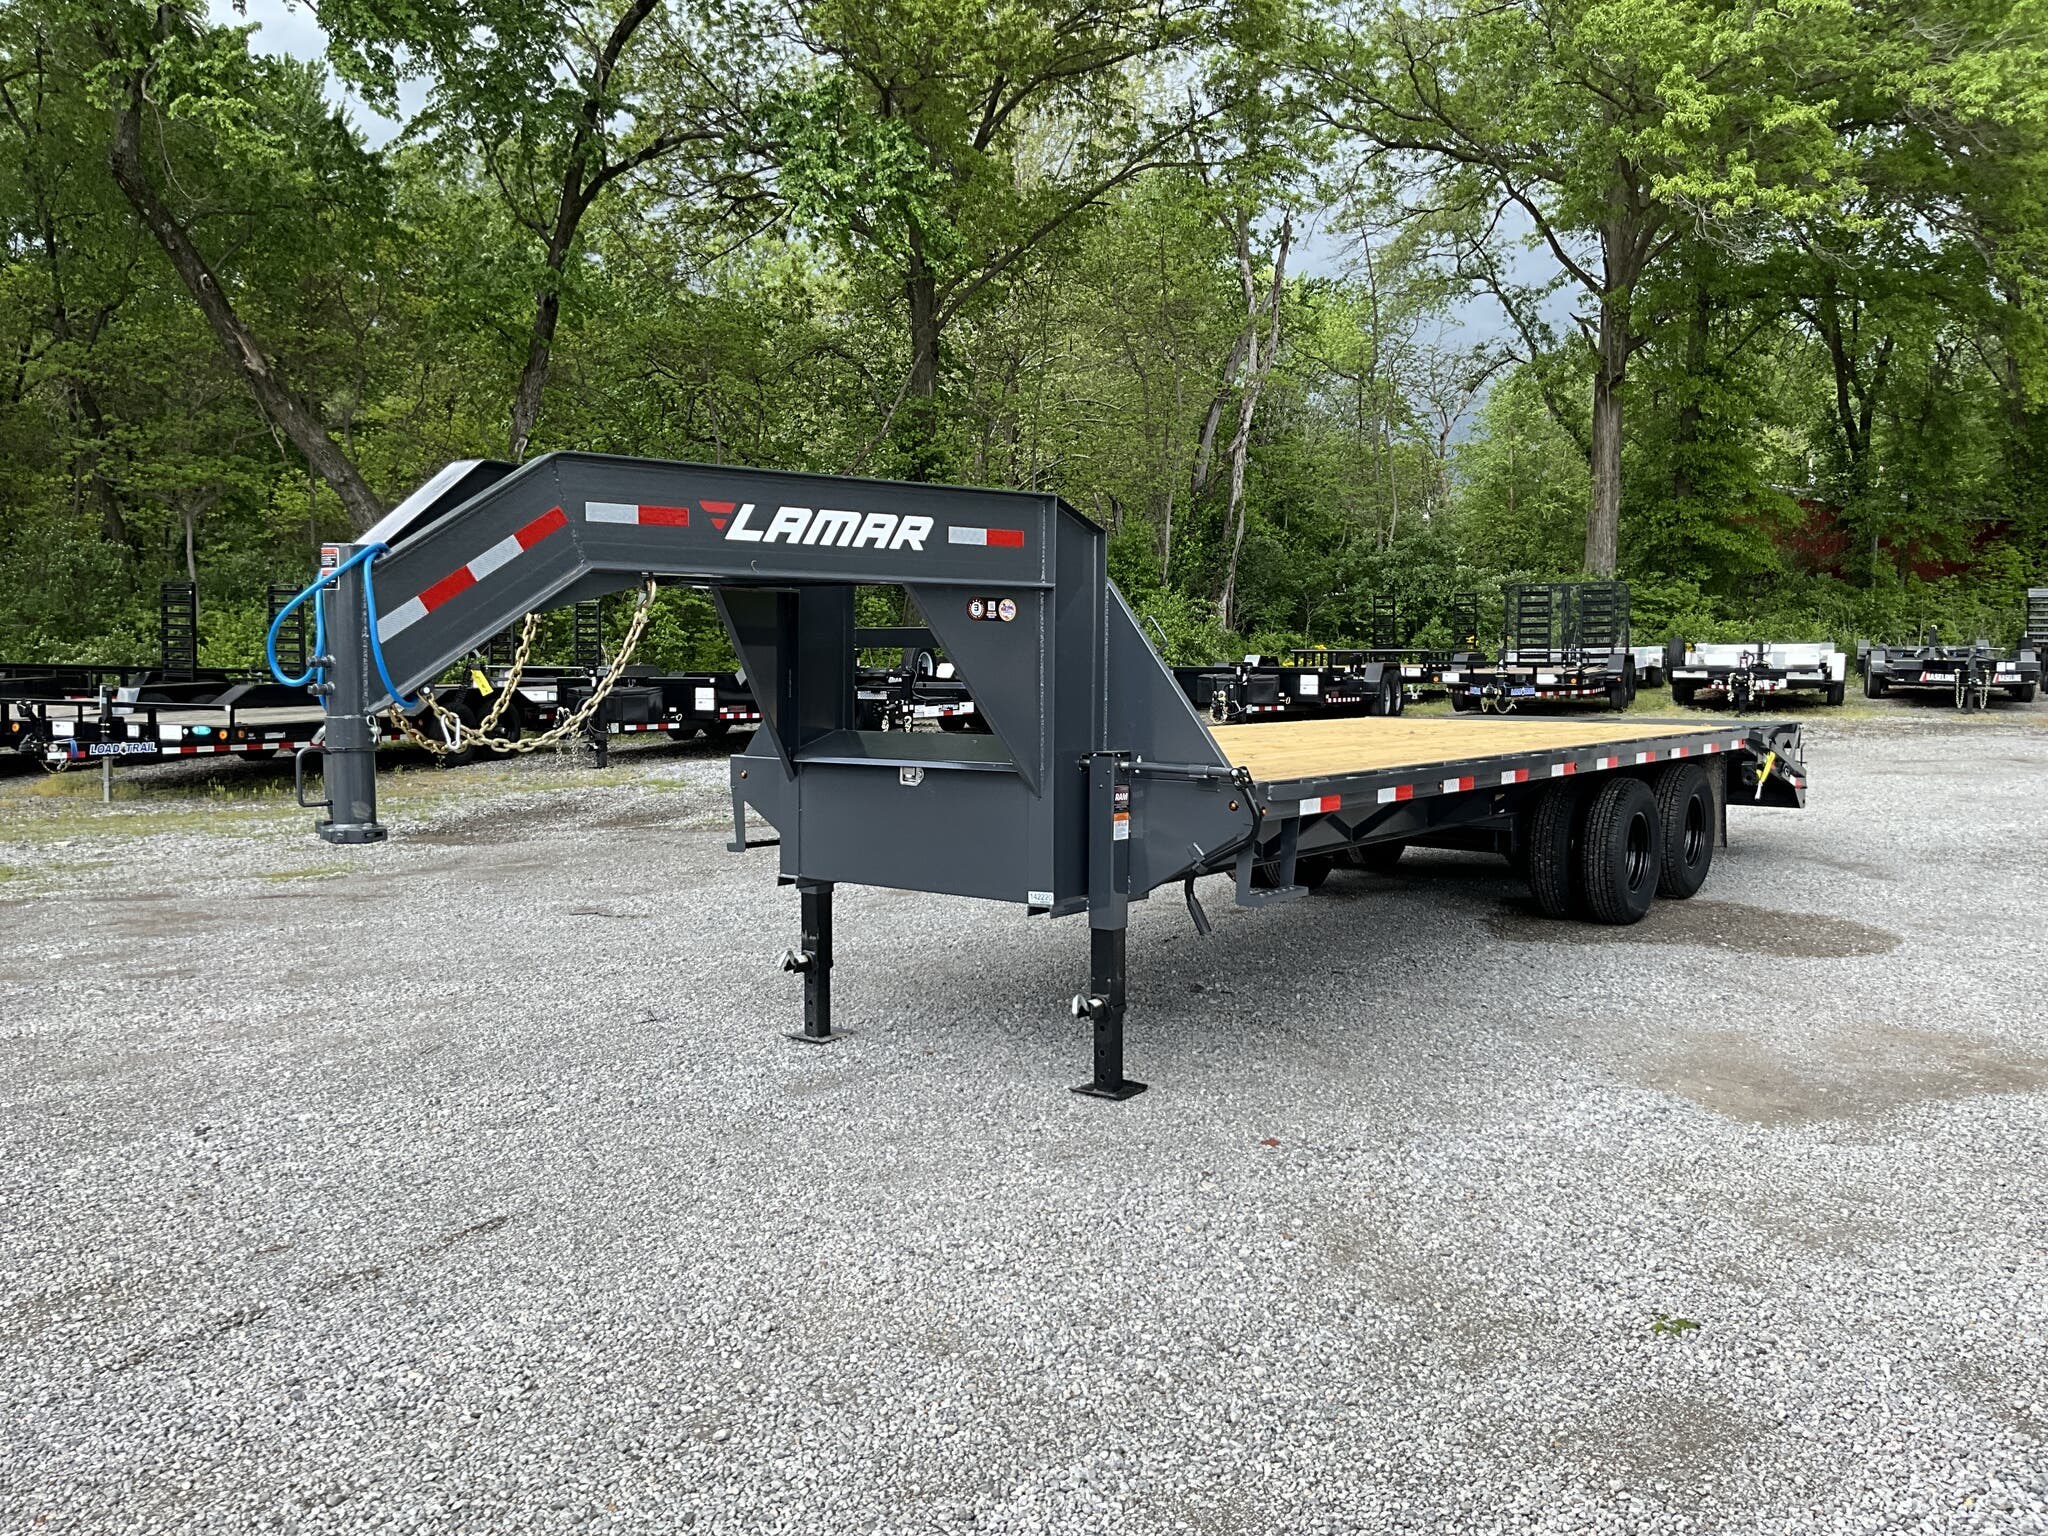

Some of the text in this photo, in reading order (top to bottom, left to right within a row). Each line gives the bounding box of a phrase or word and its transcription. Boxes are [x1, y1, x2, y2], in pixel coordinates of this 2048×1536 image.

[725, 503, 935, 551] LAMAR
[89, 742, 157, 755] LOAD TRAIL
